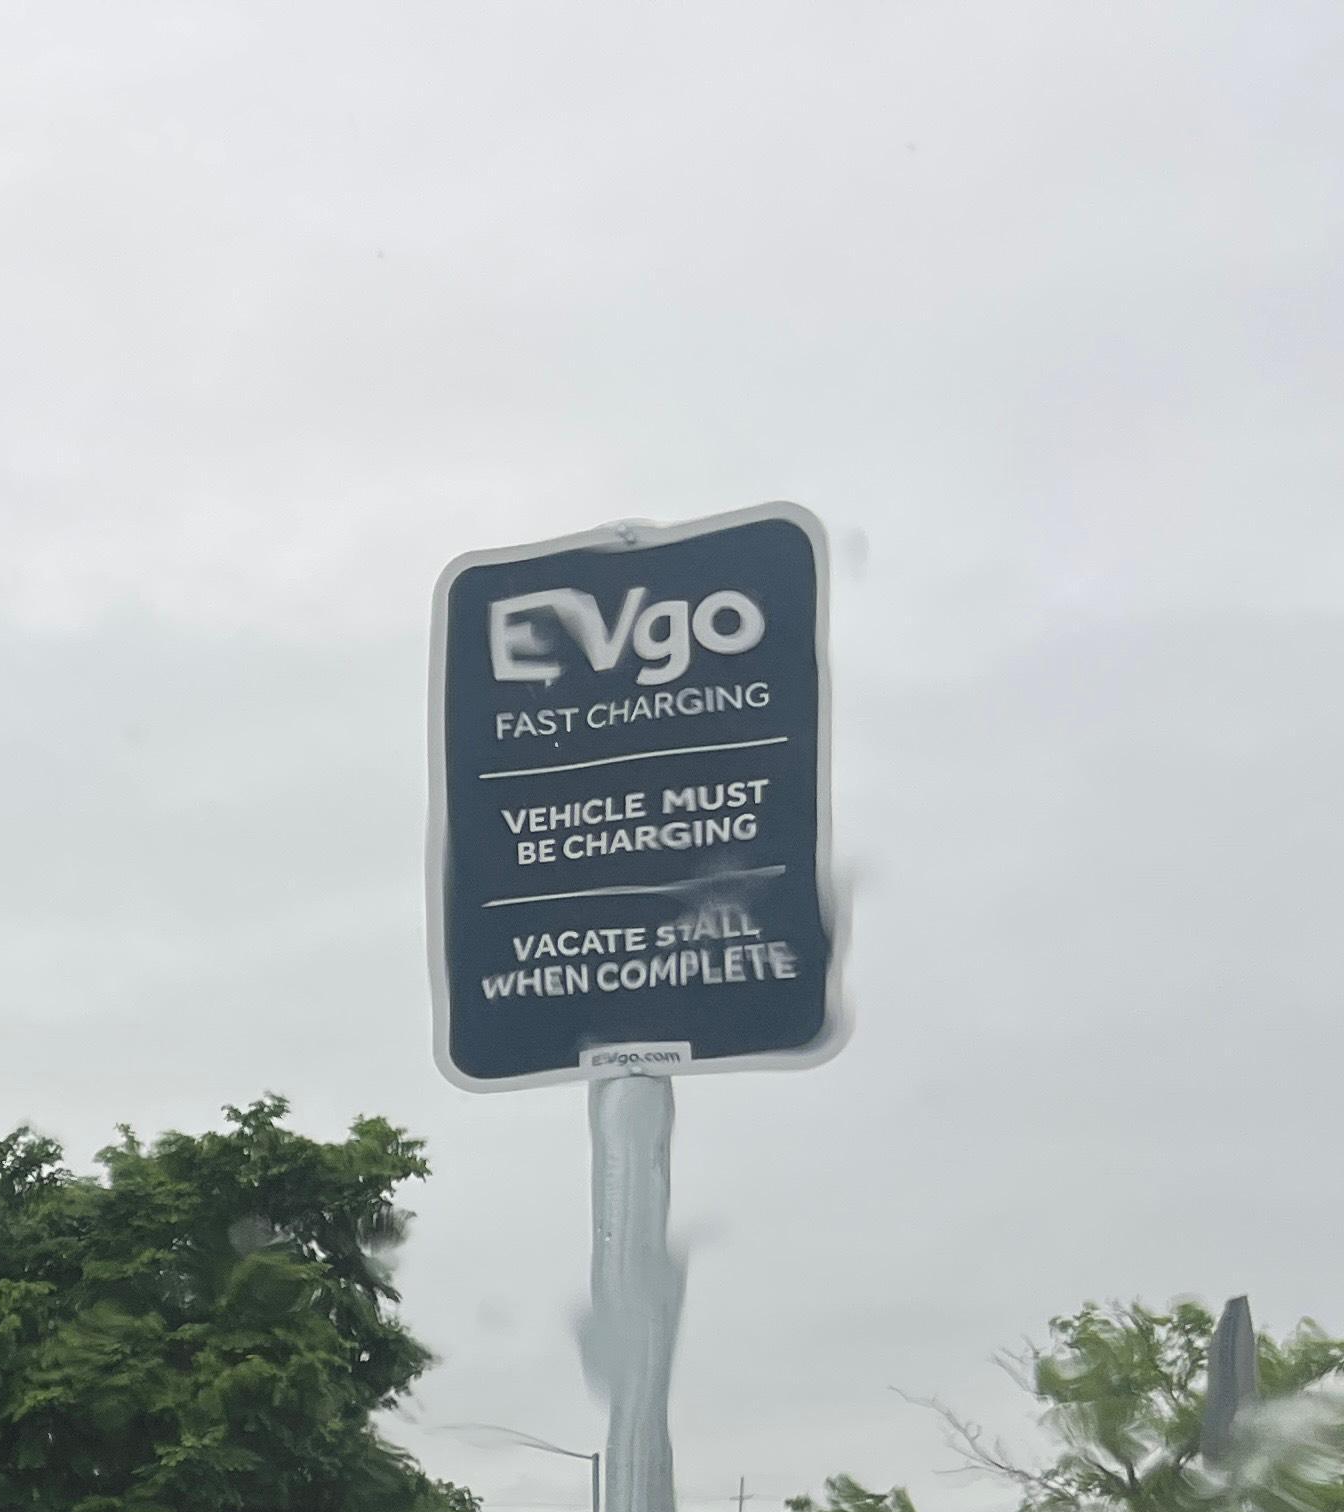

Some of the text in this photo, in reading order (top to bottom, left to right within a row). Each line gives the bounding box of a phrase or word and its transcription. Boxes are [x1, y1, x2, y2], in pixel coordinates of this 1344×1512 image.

[490, 586, 765, 686] EVgo
[496, 682, 769, 739] FAST CHARGING
[501, 778, 769, 834] VEHICLE MUST
[517, 813, 758, 866] BE CHARGING
[513, 904, 762, 962] VACATE STALL
[481, 941, 798, 1000] WHEN COMPLETE
